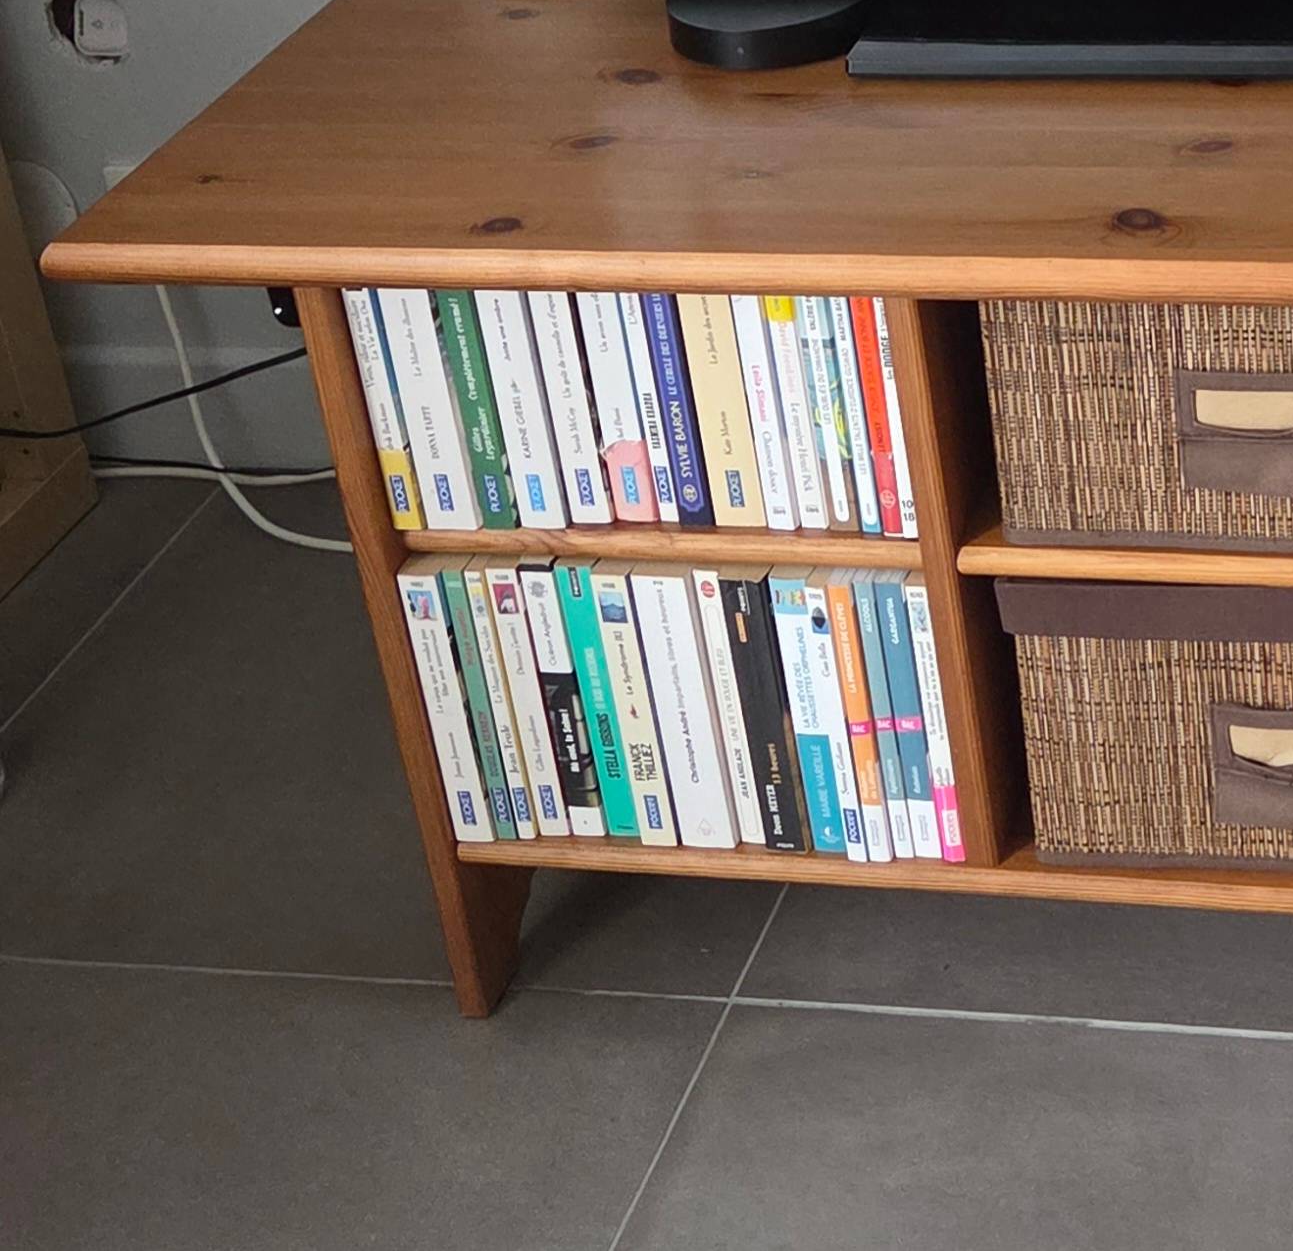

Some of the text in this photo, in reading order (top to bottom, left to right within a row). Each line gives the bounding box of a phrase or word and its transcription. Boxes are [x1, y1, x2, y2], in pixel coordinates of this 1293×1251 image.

[494, 298, 502, 321] ombre
[599, 341, 608, 353] Un
[558, 360, 566, 368] de
[817, 373, 825, 383] DU
[562, 387, 572, 398] Un
[654, 303, 692, 477] SYLVIE BARON LE CERCLE DES DERNIERS
[512, 396, 525, 425] GIEBEL
[567, 407, 578, 431] McCoy
[703, 317, 744, 506] POCKET Kate Morton Le Jardin des
[790, 402, 800, 413] Le
[823, 413, 832, 425] LES
[472, 427, 483, 452] Gilles
[478, 407, 494, 459] Legardinier
[518, 428, 531, 458] KARINE
[571, 433, 582, 453] Sarah
[756, 389, 766, 421] Slimani
[762, 431, 773, 467] Chanson
[768, 469, 777, 493] douce
[792, 415, 804, 446] mystère
[390, 476, 409, 511] POCKET
[434, 473, 454, 510] POCKET
[484, 474, 502, 511] POCKET
[526, 474, 545, 510] POCKET
[576, 469, 594, 505] POCKET
[621, 466, 640, 503] POCKET
[655, 465, 672, 502] POCKET
[802, 475, 813, 491] Pick
[901, 500, 914, 509] 10
[904, 512, 915, 522] 18
[656, 589, 668, 623] heureux
[860, 598, 872, 632] ALCOOLS
[886, 598, 899, 643] GARGANTUA
[662, 625, 671, 635] et
[840, 631, 848, 641] DE
[487, 653, 495, 665] des
[666, 637, 675, 661] libres
[716, 648, 725, 666] BLEU
[818, 642, 828, 659] Bella
[842, 640, 854, 682] PRINCESSE
[718, 667, 728, 676] ET
[796, 627, 819, 728] CHAUSSETTES ORPHELINES
[821, 661, 830, 677] Ciao
[494, 694, 503, 703] Le
[671, 664, 684, 708] Imparfaits,
[792, 662, 810, 728] LA VIE RÊVÉE DES
[848, 682, 856, 693] LA
[619, 644, 656, 780] THILLIEZ Le Syndrome
[679, 711, 690, 735] André
[726, 703, 734, 713] EN
[728, 715, 736, 725] VIE
[500, 725, 513, 749] Teulé
[596, 713, 614, 747] GIBBONS
[730, 727, 739, 741] UNE
[509, 753, 520, 773] Jean
[535, 753, 544, 771] Gilles
[604, 749, 620, 778] STELLA
[629, 744, 644, 781] FRANCK
[686, 738, 699, 783] Christophe
[734, 749, 745, 779] ANGLADE
[768, 743, 781, 785] 13 heures
[740, 781, 749, 798] JEAN
[810, 745, 830, 817] MARIE VAREILLE
[457, 791, 477, 825] POCKET
[491, 787, 509, 821] POCKET
[513, 788, 531, 821] POCKET
[539, 785, 558, 818] POCKET
[645, 795, 662, 828] POCKET
[766, 785, 782, 835] Deon MEYER
[845, 809, 860, 841] POCKET
[945, 812, 959, 842] POCKET
